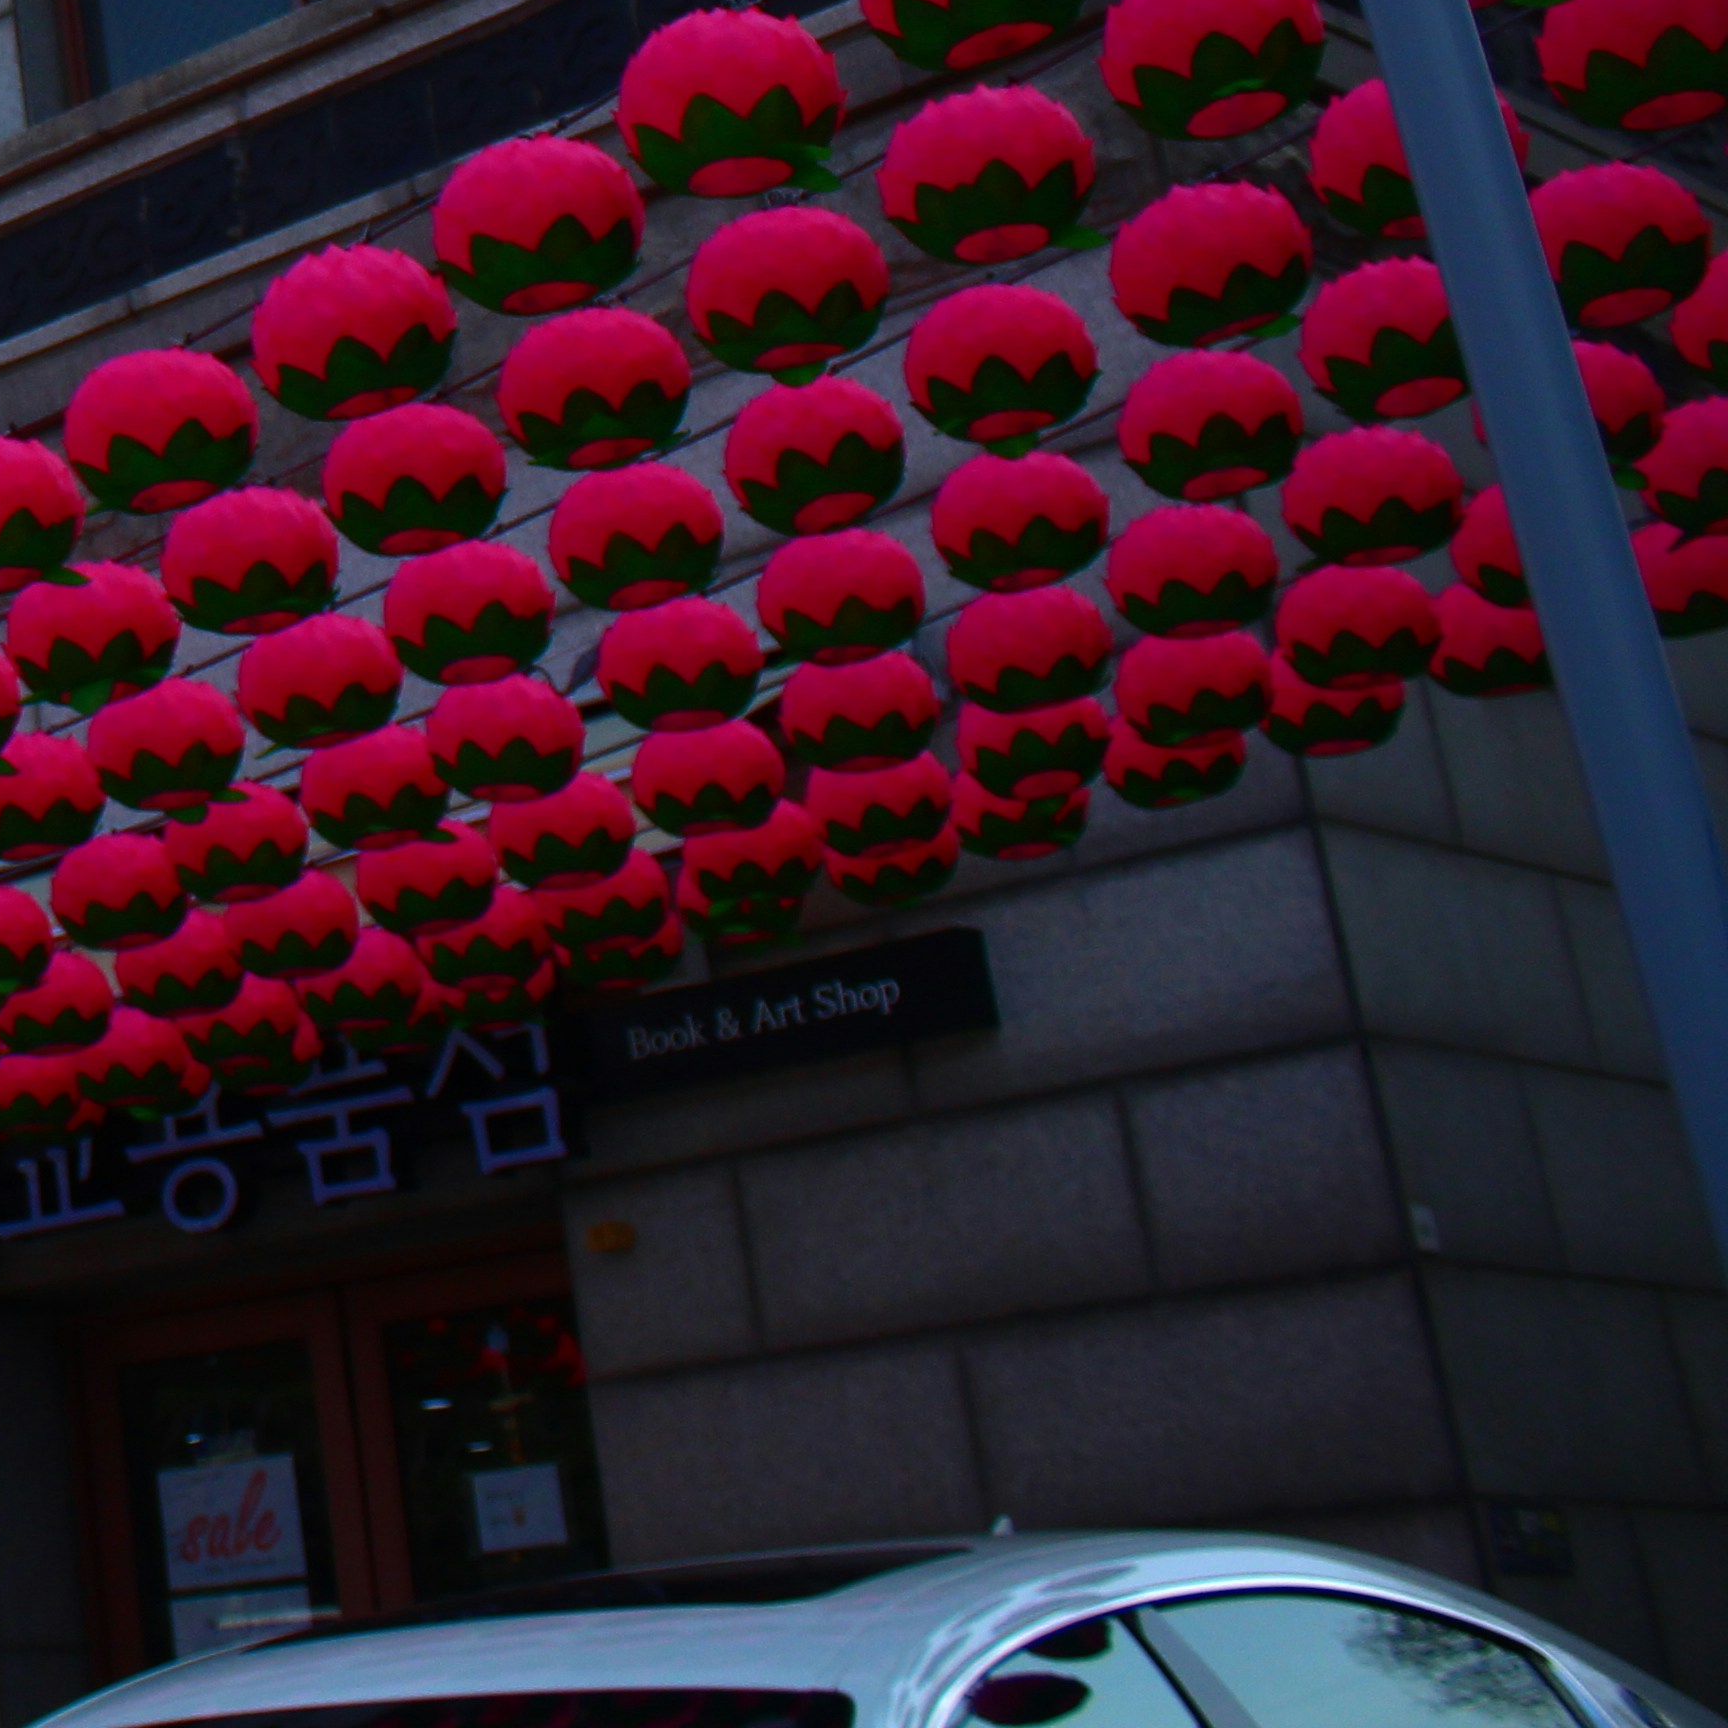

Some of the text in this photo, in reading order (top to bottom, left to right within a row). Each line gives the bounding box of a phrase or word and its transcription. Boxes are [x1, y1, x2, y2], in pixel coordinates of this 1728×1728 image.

[625, 977, 901, 1060] Book & Art Shop
[181, 1470, 283, 1563] sale
